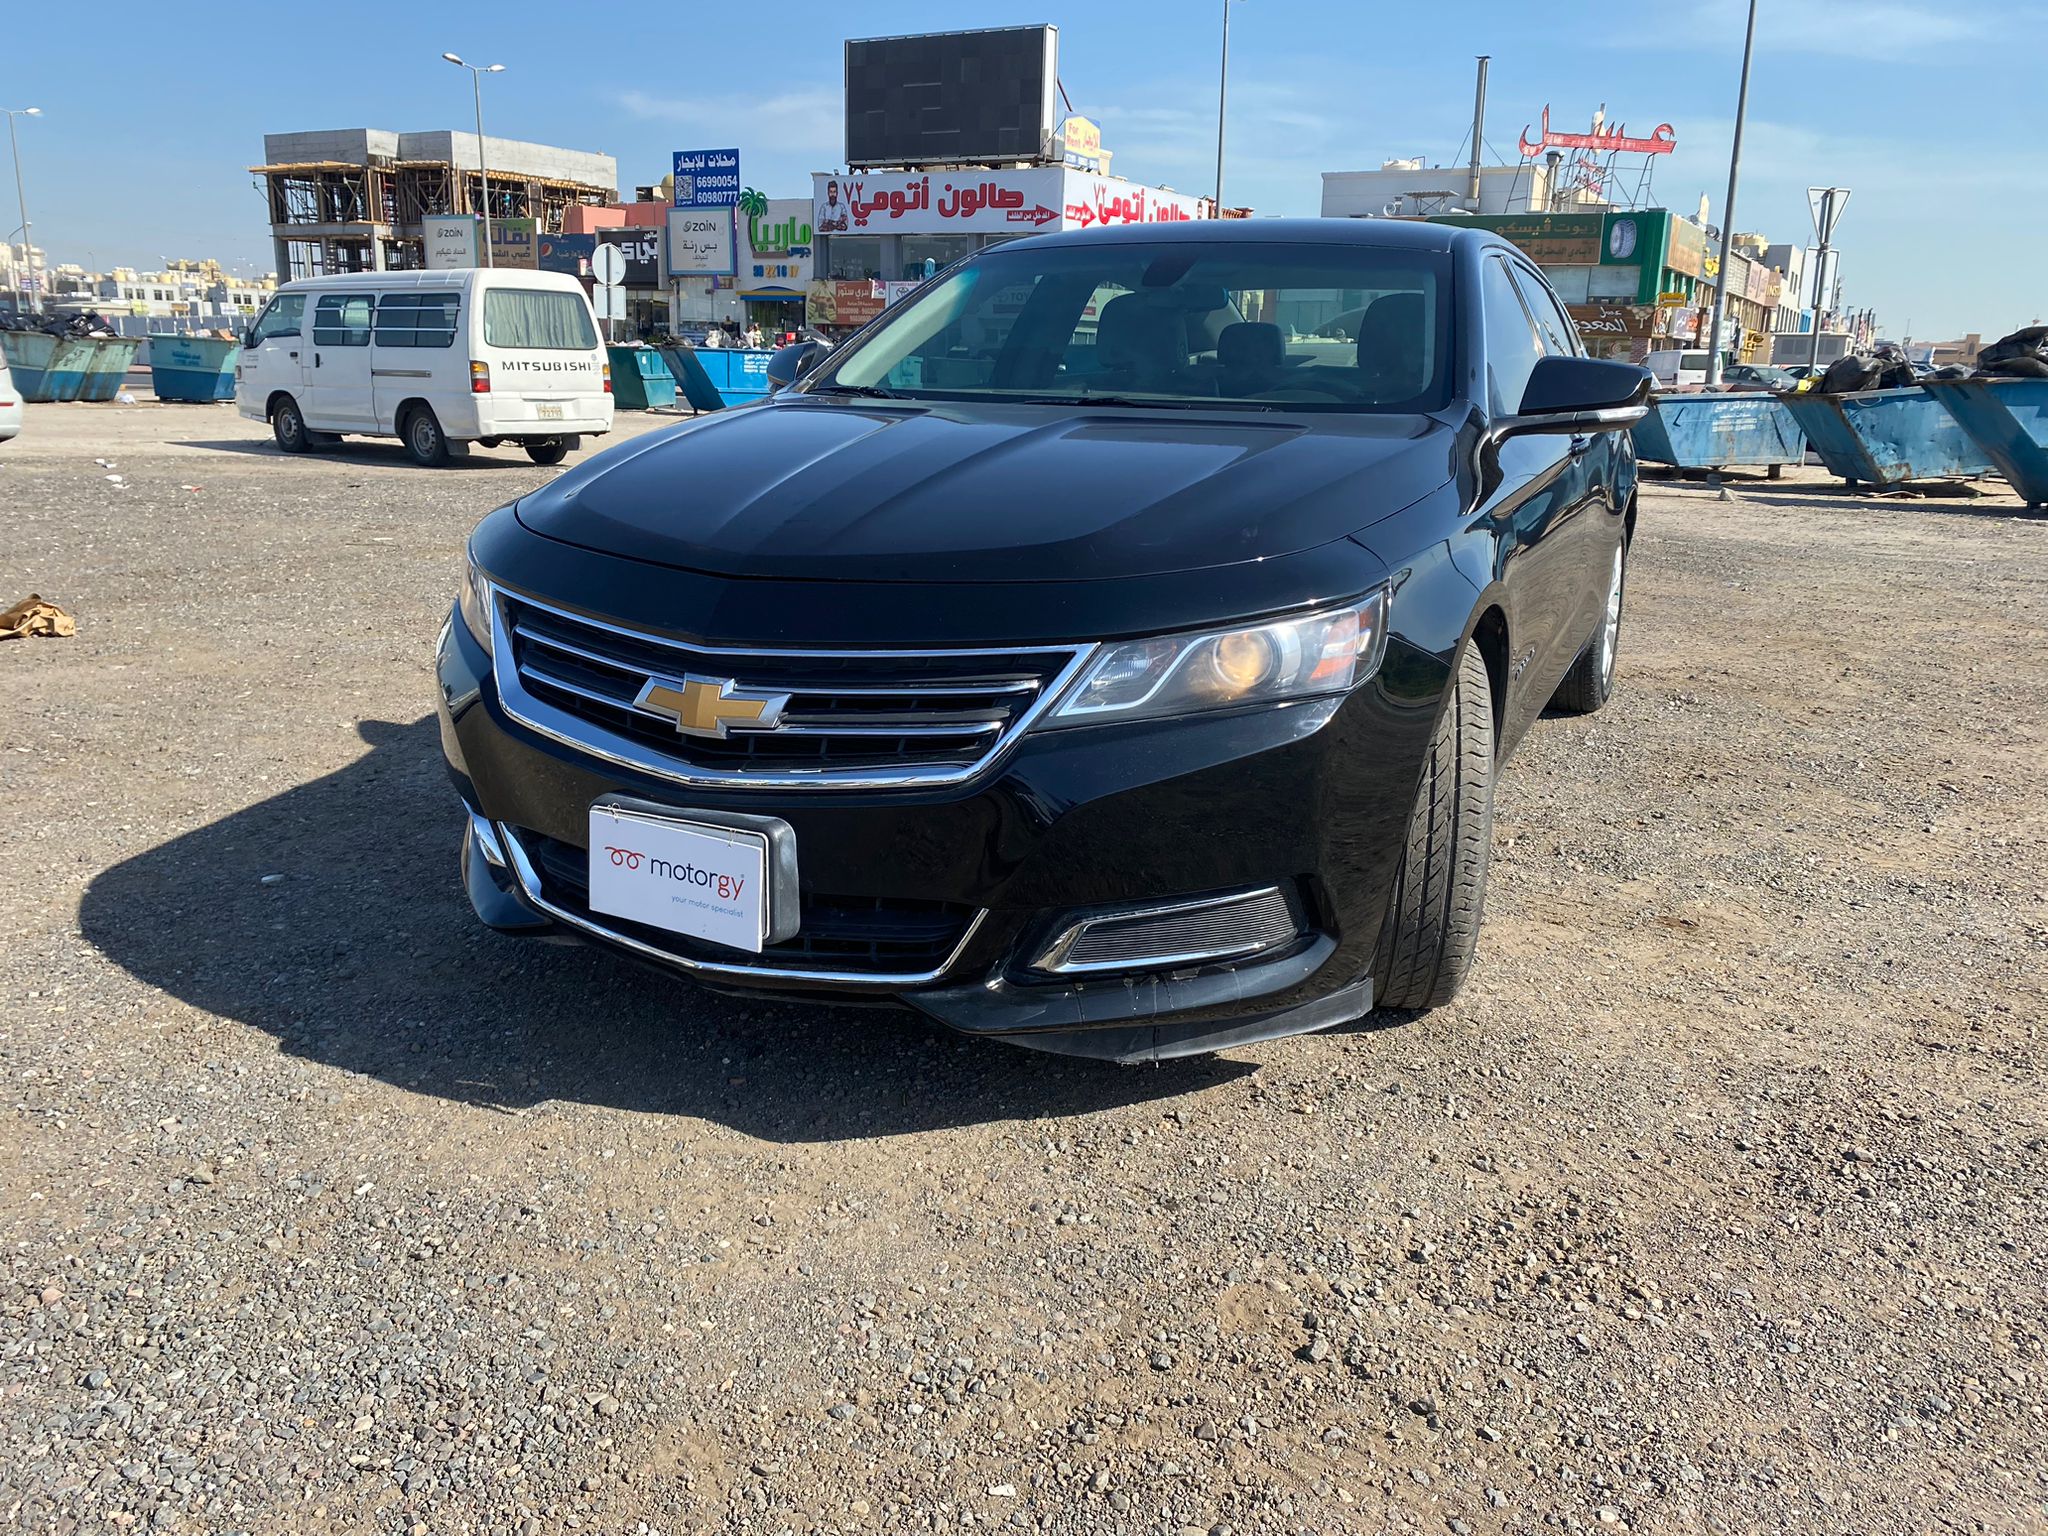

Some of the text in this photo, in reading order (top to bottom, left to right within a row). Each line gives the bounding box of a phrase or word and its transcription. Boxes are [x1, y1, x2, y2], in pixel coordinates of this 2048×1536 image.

[677, 153, 736, 172] محلات للإيجار
[696, 175, 738, 188] 66990054
[697, 191, 738, 203] 60980777
[851, 176, 930, 227] أتومي
[938, 182, 1024, 218] صالون
[502, 361, 592, 371] MITSUBISHI
[650, 858, 745, 901] motorgy
[671, 895, 744, 919] your motor specialist
